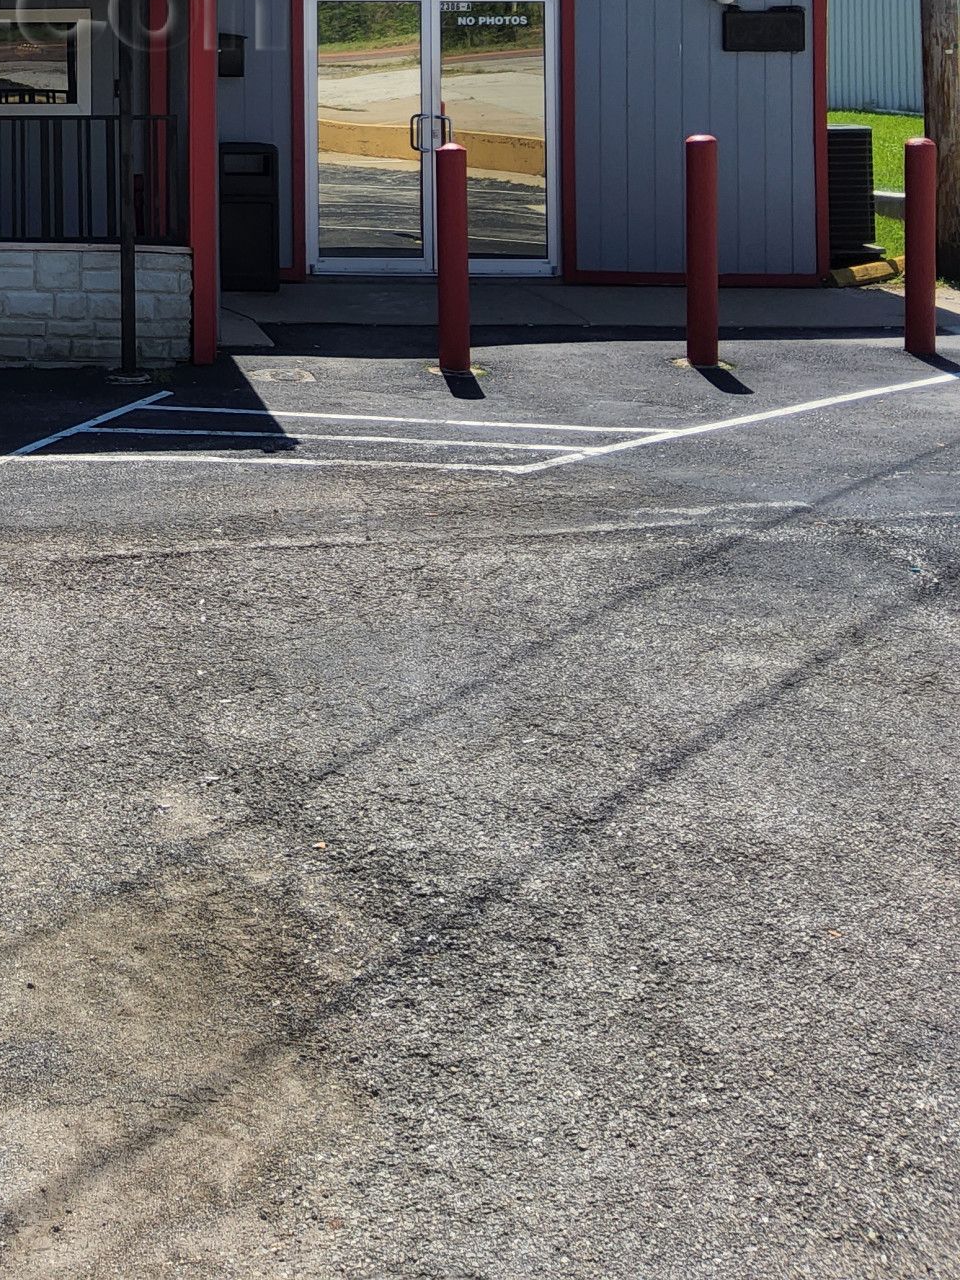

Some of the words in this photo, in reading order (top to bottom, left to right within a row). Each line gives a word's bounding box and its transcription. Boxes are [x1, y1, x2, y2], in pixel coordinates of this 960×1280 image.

[440, 2, 471, 11] 2306-A
[458, 16, 475, 25] NO
[478, 15, 528, 25] PHOTOS
